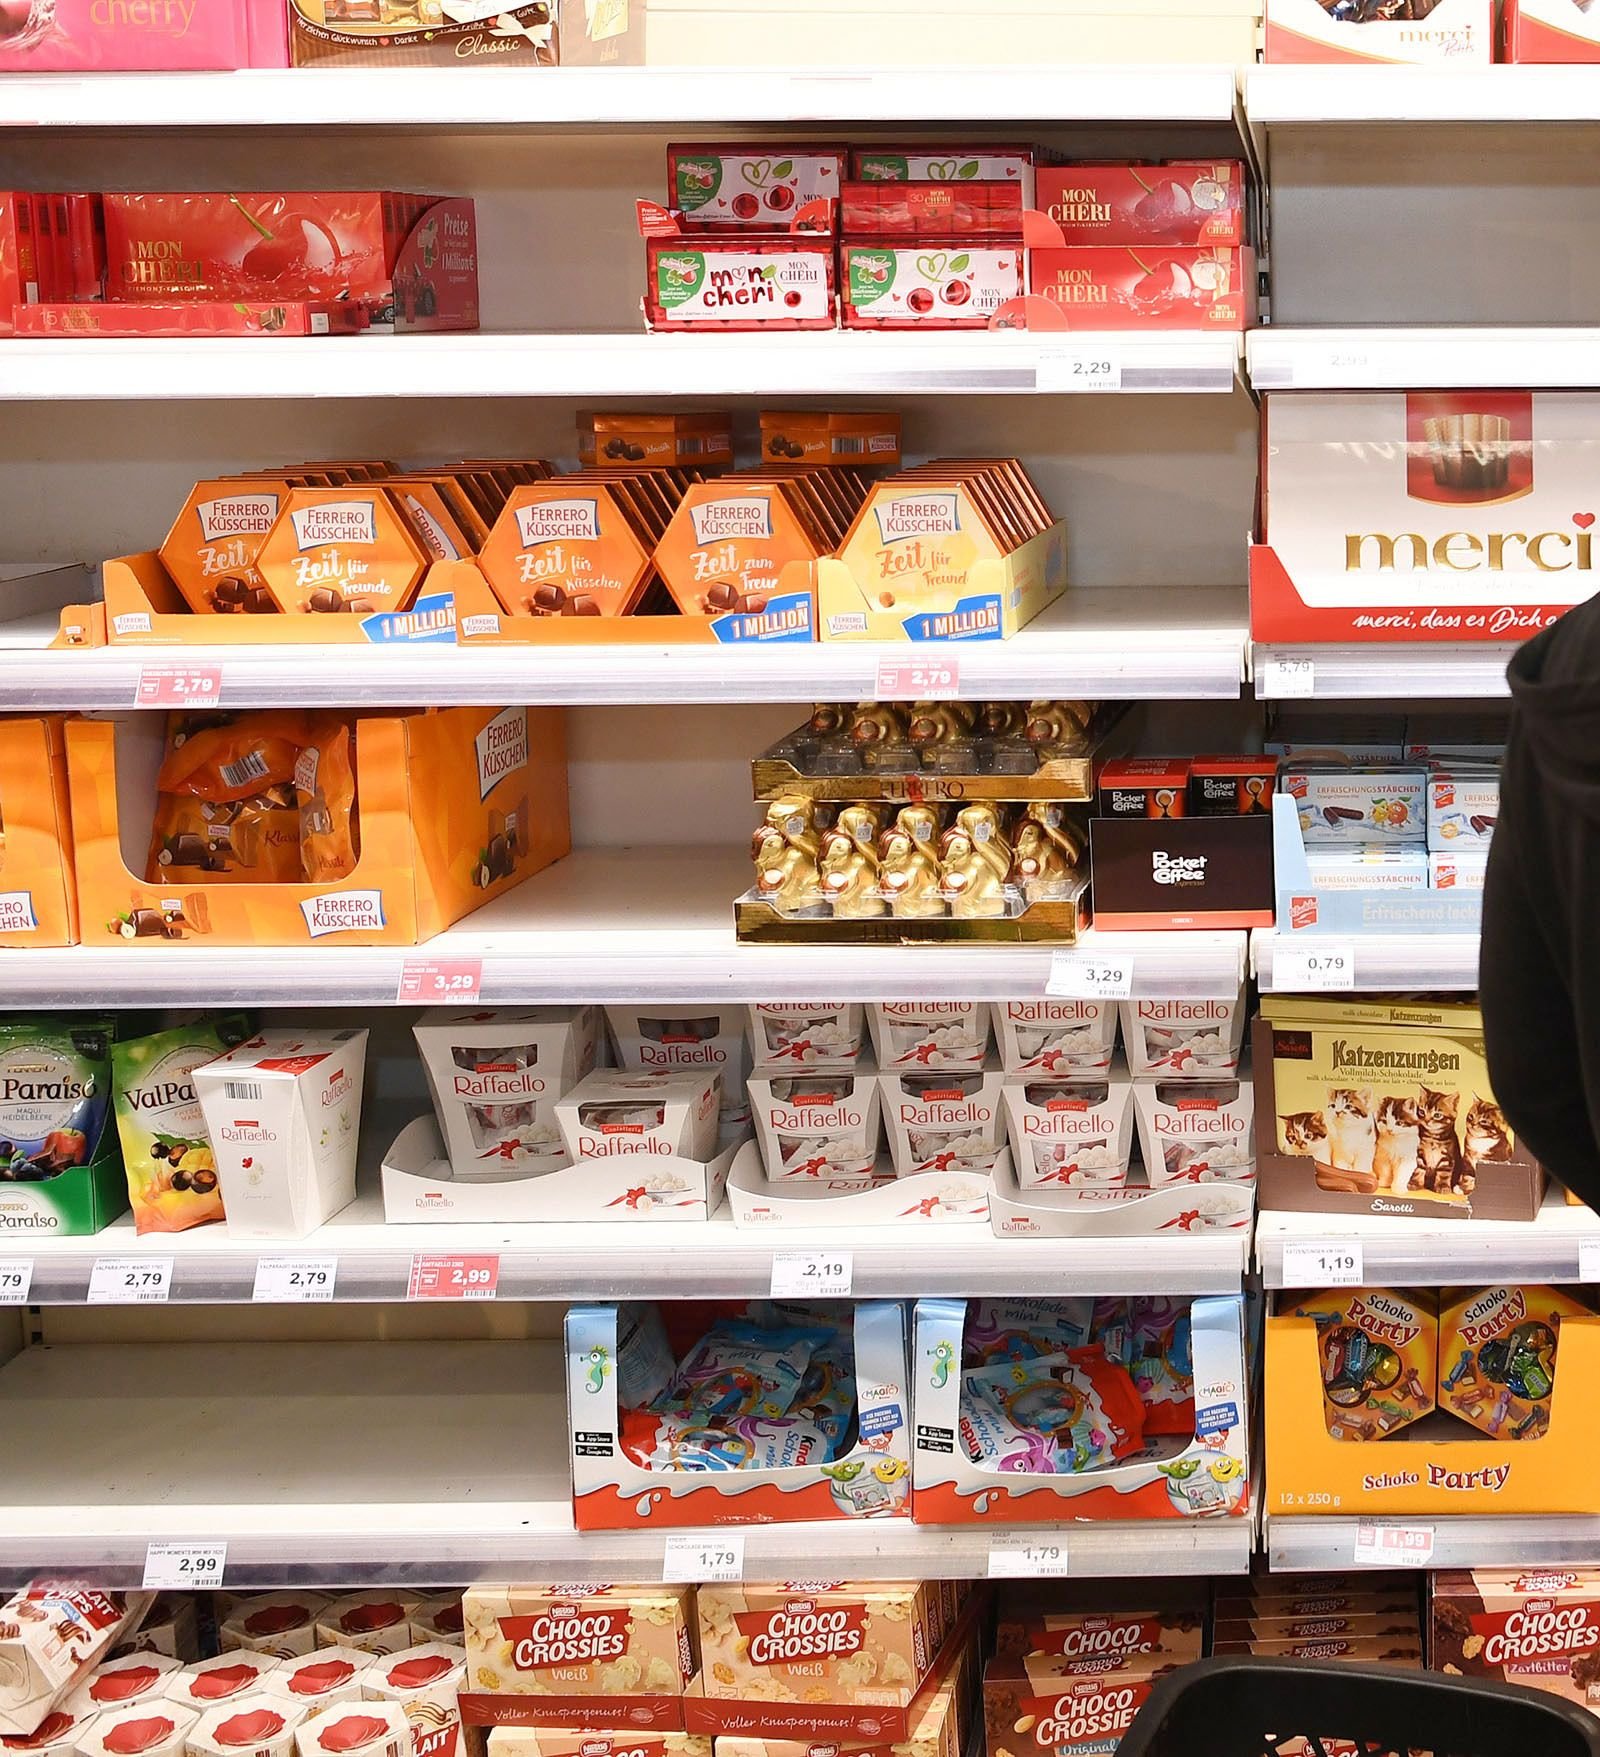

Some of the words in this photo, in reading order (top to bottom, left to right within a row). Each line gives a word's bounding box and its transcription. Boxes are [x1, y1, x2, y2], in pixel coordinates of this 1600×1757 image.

[454, 32, 521, 58] Classic
[1062, 189, 1096, 202] MON
[1057, 269, 1092, 283] MON
[703, 281, 774, 307] chéri
[1073, 362, 1112, 376] 2,29
[307, 510, 364, 527] FERRERO
[531, 507, 588, 524] FERRERO
[706, 504, 761, 521] FERRERO
[891, 502, 948, 519] FERRERO
[301, 522, 370, 542] KÜSSCHEN
[526, 520, 592, 540] KÜSSCHEN
[701, 516, 765, 536] KÜSSCHEN
[886, 515, 953, 535] KÜSSCHEN
[1345, 512, 1596, 573] merci
[291, 549, 341, 587] Zeit
[517, 546, 567, 584] Zeit
[689, 545, 739, 581] Zeit
[744, 558, 775, 572] zum
[341, 578, 392, 597] Freunde
[566, 575, 622, 593] Küsschen
[732, 621, 741, 638] 1
[744, 608, 808, 636] MILLION
[922, 620, 931, 638] 1
[933, 608, 998, 636] MILLION
[1352, 610, 1419, 632] merci,
[1420, 611, 1462, 628] dass
[1465, 614, 1486, 627] es
[1490, 606, 1543, 633] Dich
[1279, 660, 1311, 675] 5,79
[911, 670, 951, 685] 2,79
[1203, 779, 1238, 792] Pocket
[1204, 786, 1236, 799] Coffee
[1316, 784, 1421, 794] ERFRISCHUNGSSTÄBCHEN
[1112, 790, 1146, 805] Pocket
[1113, 798, 1146, 813] Coffee
[1152, 851, 1208, 873] Pocket
[1362, 903, 1443, 922] Erfrischend
[1307, 958, 1345, 970] 0,79
[434, 975, 474, 991] 3,29
[1085, 968, 1123, 983] 3,29
[1332, 1040, 1460, 1073] Katzenzungen
[1339, 1067, 1424, 1079] Vollmilch-Schokolade
[453, 1075, 546, 1097] Raffaello
[2, 1113, 53, 1122] HEIDELBEERE
[16, 1107, 42, 1115] MAQUI
[769, 1107, 862, 1130] Raffaello
[900, 1103, 991, 1125] Raffaello
[415, 1198, 455, 1209] Raffaello
[1370, 1199, 1414, 1214] Sarotti
[1001, 1221, 1041, 1233] Raffaello
[1318, 1256, 1354, 1271] 1,19
[125, 1273, 163, 1288] 2,79
[290, 1272, 328, 1287] 2,79
[451, 1270, 491, 1285] 2,99
[1365, 1294, 1414, 1323] Schoko
[1463, 1288, 1508, 1324] Schoko
[1004, 1309, 1041, 1322] mini
[1345, 1297, 1420, 1348] Party
[1458, 1290, 1527, 1347] Party
[1362, 1469, 1420, 1490] Schoko
[1427, 1462, 1511, 1493] Party
[1279, 1493, 1294, 1505] 12
[1296, 1496, 1304, 1505] x
[1306, 1493, 1331, 1505] 250
[1333, 1496, 1341, 1508] g
[1389, 1532, 1425, 1548] 1,99
[699, 1552, 736, 1568] 1,79
[1022, 1546, 1061, 1561] 1,79
[179, 1559, 217, 1575] 2,99
[531, 1614, 611, 1642] CHOCO
[767, 1611, 847, 1637] CHOCO
[1505, 1608, 1588, 1638] CHOCO
[514, 1633, 625, 1664] CROSSIES
[751, 1630, 861, 1660] CROSSIES
[1485, 1625, 1600, 1662] CROSSIES
[551, 1666, 589, 1681] Weiß
[786, 1662, 825, 1677] Weiß
[1053, 1689, 1135, 1720] CHOCO
[494, 1709, 529, 1722] Voller
[721, 1717, 757, 1729] Voller
